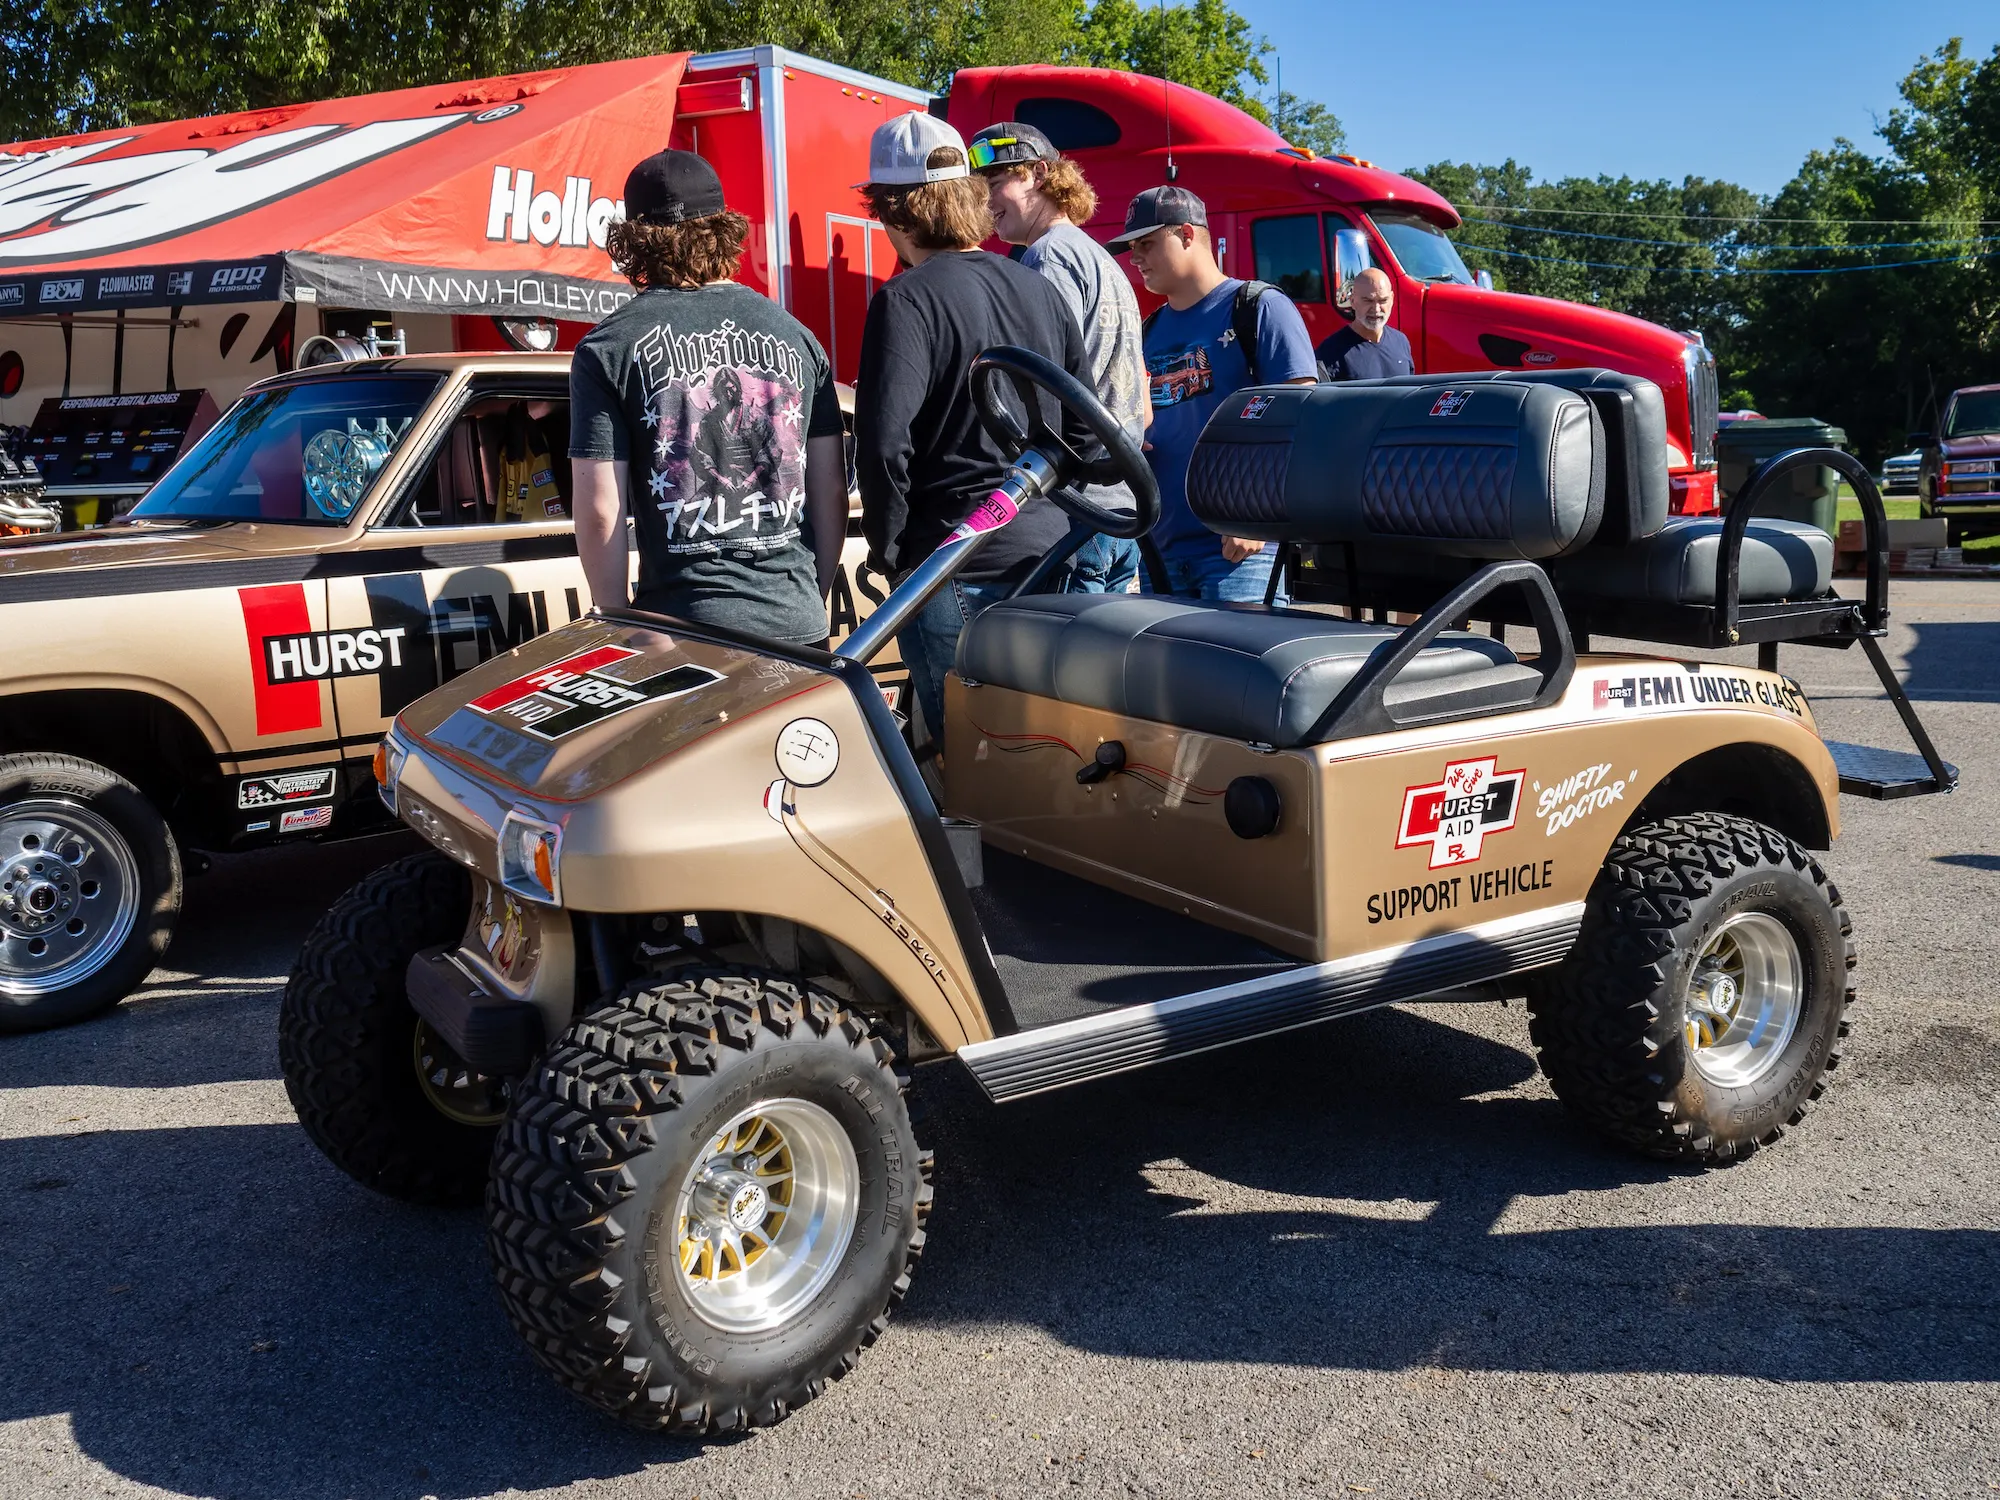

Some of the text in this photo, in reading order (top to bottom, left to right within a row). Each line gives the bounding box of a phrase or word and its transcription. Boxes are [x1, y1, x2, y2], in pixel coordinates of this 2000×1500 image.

[486, 164, 628, 258] Holle
[98, 275, 154, 299] FLOWMASTER
[208, 283, 261, 293] MOTORSPORT
[211, 266, 267, 286] APR
[42, 281, 82, 300] B&M
[377, 270, 640, 314] WWW.HOLLEY.CO
[634, 319, 805, 406] Elysium
[59, 393, 180, 409] PERFORMANCE DIGITAL DASHES
[1437, 399, 1465, 407] HURST
[547, 503, 564, 515] FR
[269, 627, 406, 680] HURST
[526, 668, 648, 709] HURST
[1600, 687, 1633, 698] HURST
[1689, 676, 1754, 704] UNDER
[1756, 680, 1803, 717] GLASS
[503, 699, 554, 722] AID
[30, 781, 96, 799] 5/65R1
[281, 784, 321, 794] BATTERIES
[283, 777, 326, 788] INTERSTATE
[1448, 768, 1465, 788] We
[1463, 768, 1483, 794] Give
[1429, 792, 1498, 820] HURST
[1445, 819, 1474, 838] AID
[1367, 860, 1553, 924] SUPPORT VEHICLE
[1717, 881, 1778, 917] TRAIL
[881, 907, 947, 983] HURST
[1732, 1031, 1824, 1125] CARLISLE
[839, 1073, 903, 1237] ALL TRAIL
[643, 1210, 717, 1377] CARLISLE
